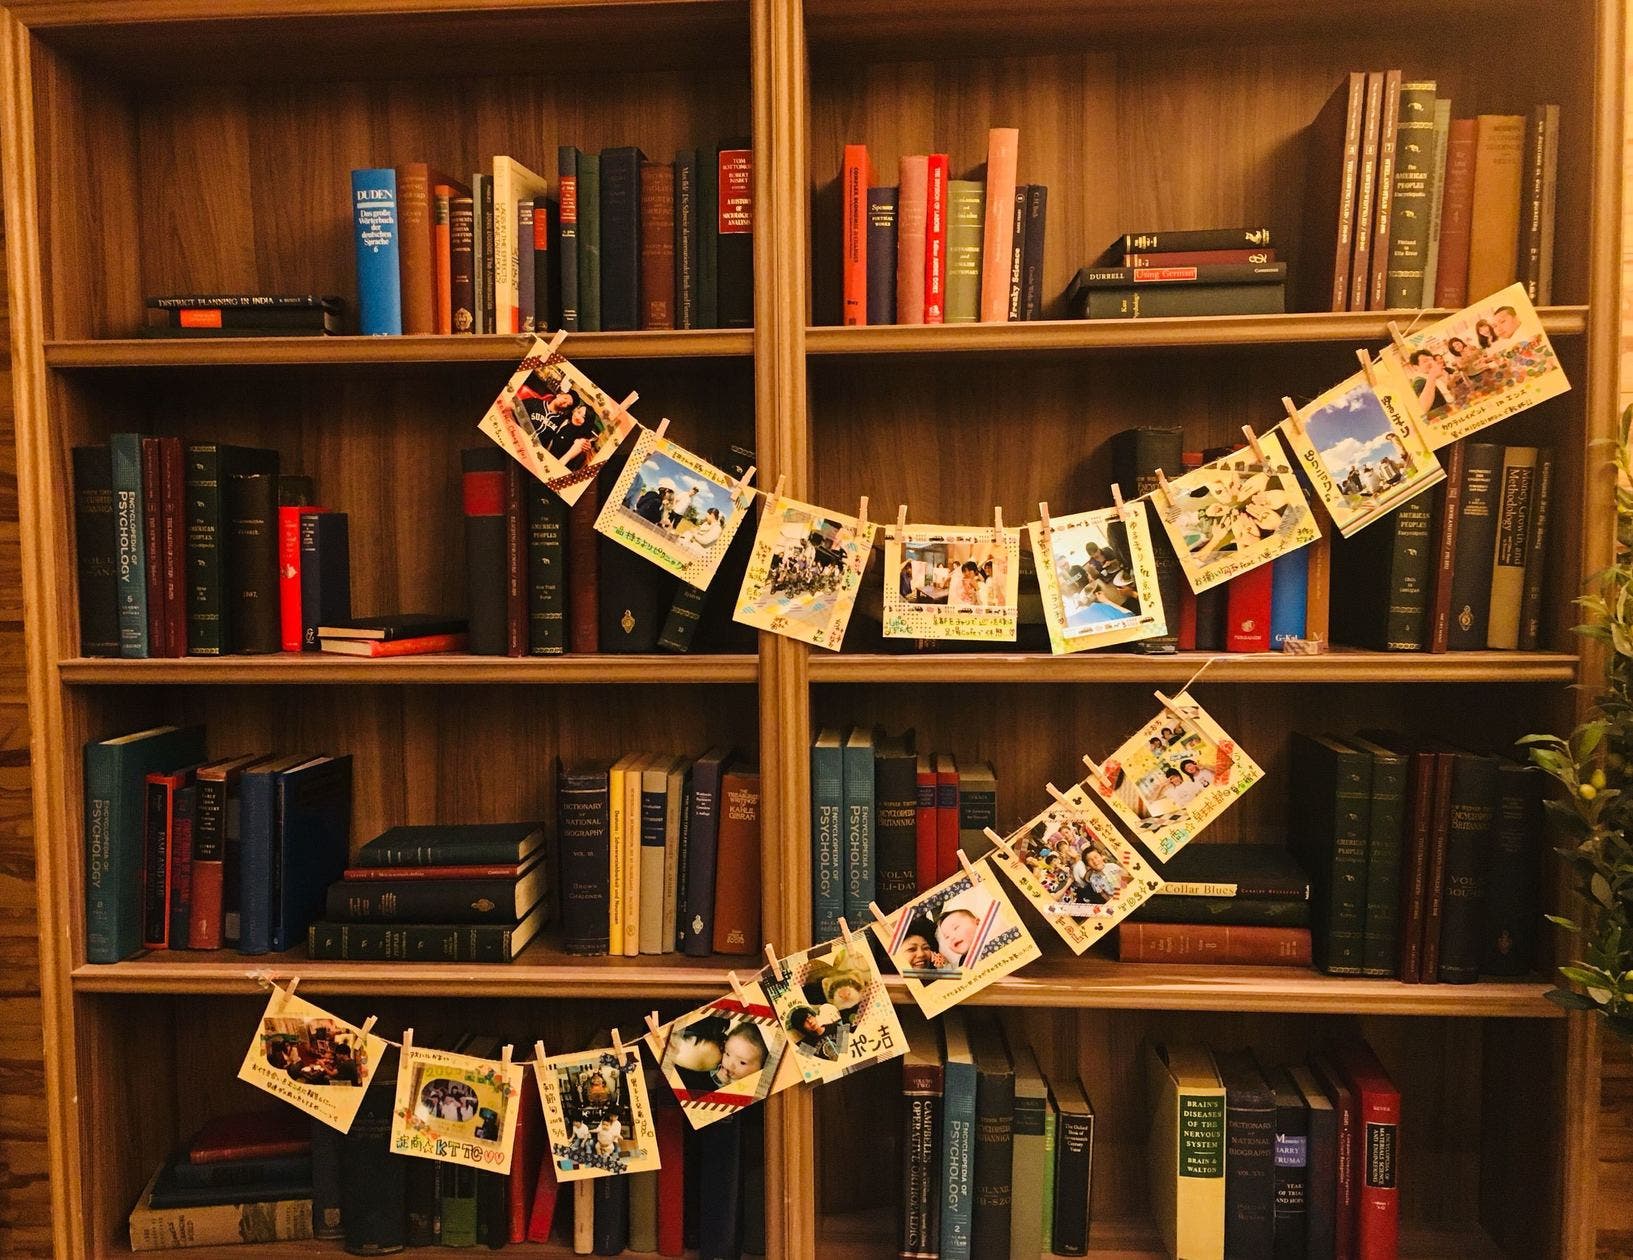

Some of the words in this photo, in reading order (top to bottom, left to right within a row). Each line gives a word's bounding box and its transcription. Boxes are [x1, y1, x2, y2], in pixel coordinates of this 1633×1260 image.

[1395, 172, 1427, 180] AMERICAN
[356, 189, 393, 200] DUDEN
[934, 202, 940, 210] OF
[360, 209, 375, 217] Das
[374, 209, 391, 218] große
[358, 216, 394, 225] Wörterbuch
[370, 223, 381, 231] der
[361, 231, 392, 239] deutschen
[363, 238, 390, 246] Sprache
[1012, 247, 1021, 284] Science
[1135, 269, 1160, 280] Using
[1161, 269, 1195, 278] German
[158, 299, 195, 307] DISTRICT
[197, 297, 238, 306] PLANNING
[240, 297, 249, 305] IN
[251, 296, 274, 305] INDIA
[1009, 285, 1019, 318] Freaky
[1520, 469, 1531, 503] Money,
[1502, 469, 1520, 532] Methodology
[128, 491, 138, 553] ENCYCLOPEDIA
[1517, 504, 1528, 547] Growth,
[117, 490, 130, 583] PSYCHOLOGY
[131, 554, 138, 566] OF
[1515, 547, 1523, 565] and
[565, 818, 601, 826] NATIONAL
[728, 812, 756, 820] GIBRAN
[102, 799, 110, 859] ENCYCLOPEDIA
[564, 829, 604, 837] BIOGRAPHY
[831, 806, 839, 867] ENCYCLOPEDIA
[861, 806, 869, 867] ENCYCLOPEDIA
[90, 799, 102, 888] PSYCHOLOGY
[820, 805, 831, 898] PSYCHOLOGY
[850, 805, 860, 898] PSYCHOLOGY
[103, 862, 110, 872] OF
[833, 868, 839, 881] OF
[862, 868, 868, 881] OF
[1204, 884, 1235, 895] Blues
[849, 1024, 894, 1058] ポン吉
[1187, 1100, 1219, 1108] BRAIN'S
[1183, 1110, 1222, 1118] DISEASES
[1229, 1121, 1272, 1129] DICTIONARY
[911, 1100, 921, 1163] OPERATIVE
[1183, 1130, 1221, 1138] NERVOUS
[1231, 1137, 1270, 1145] NATIONAL
[961, 1122, 970, 1183] ENCYCLOPEDIA
[1229, 1148, 1271, 1156] BIOGRAPHY
[949, 1120, 961, 1212] PSYCHOLOGY
[961, 1184, 968, 1196] OF
[909, 1165, 920, 1247] ORTHOPAEDICS
[954, 1225, 960, 1233] 2
